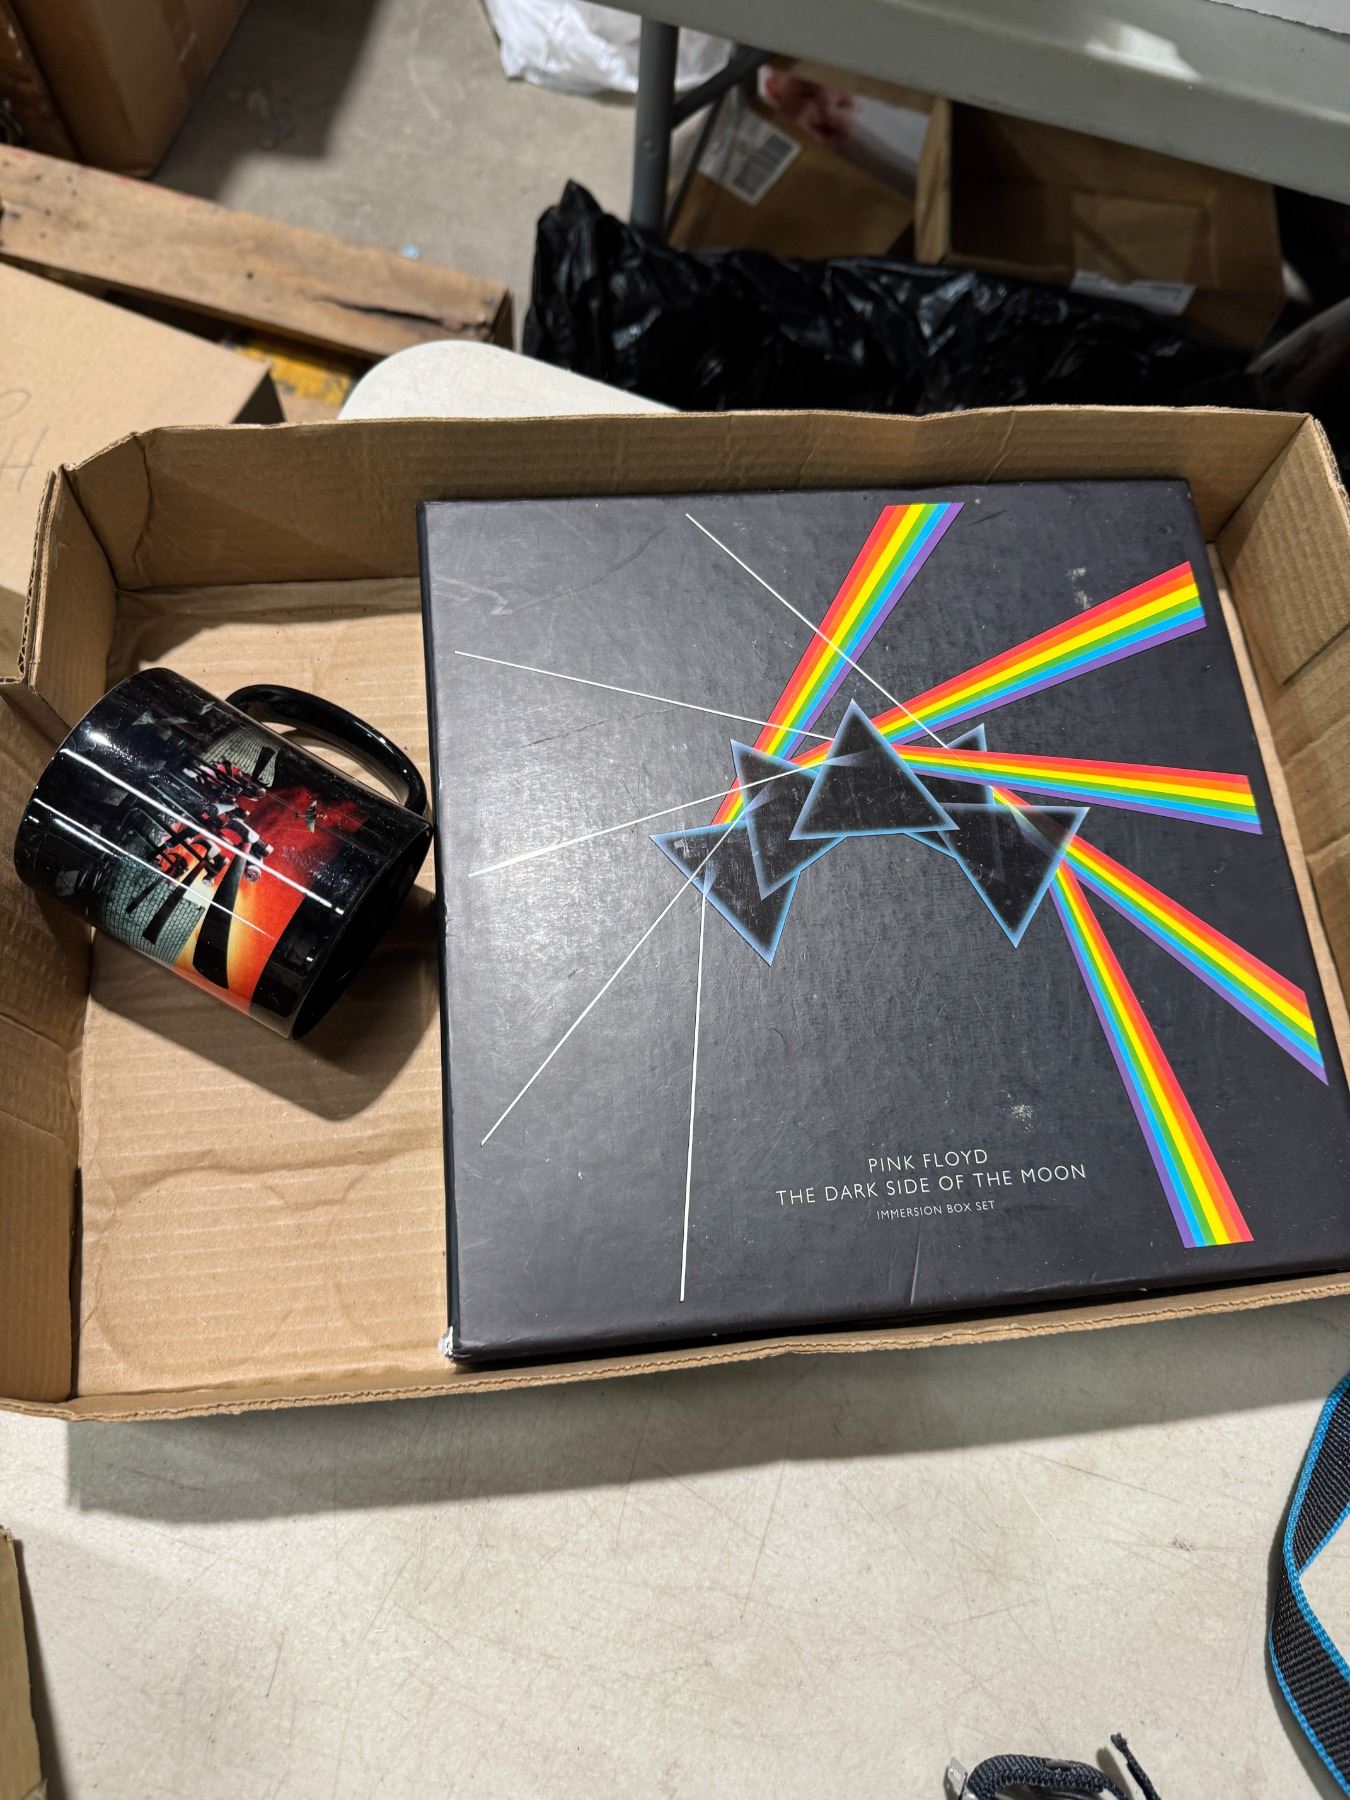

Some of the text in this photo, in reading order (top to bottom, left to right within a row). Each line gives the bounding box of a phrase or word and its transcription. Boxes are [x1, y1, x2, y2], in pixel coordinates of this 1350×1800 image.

[868, 1148, 988, 1174] PINK FLOYD
[775, 1163, 1087, 1206] THE DARK SIDE OF THE MOON
[876, 1199, 995, 1220] IMMERSION BOX SET
